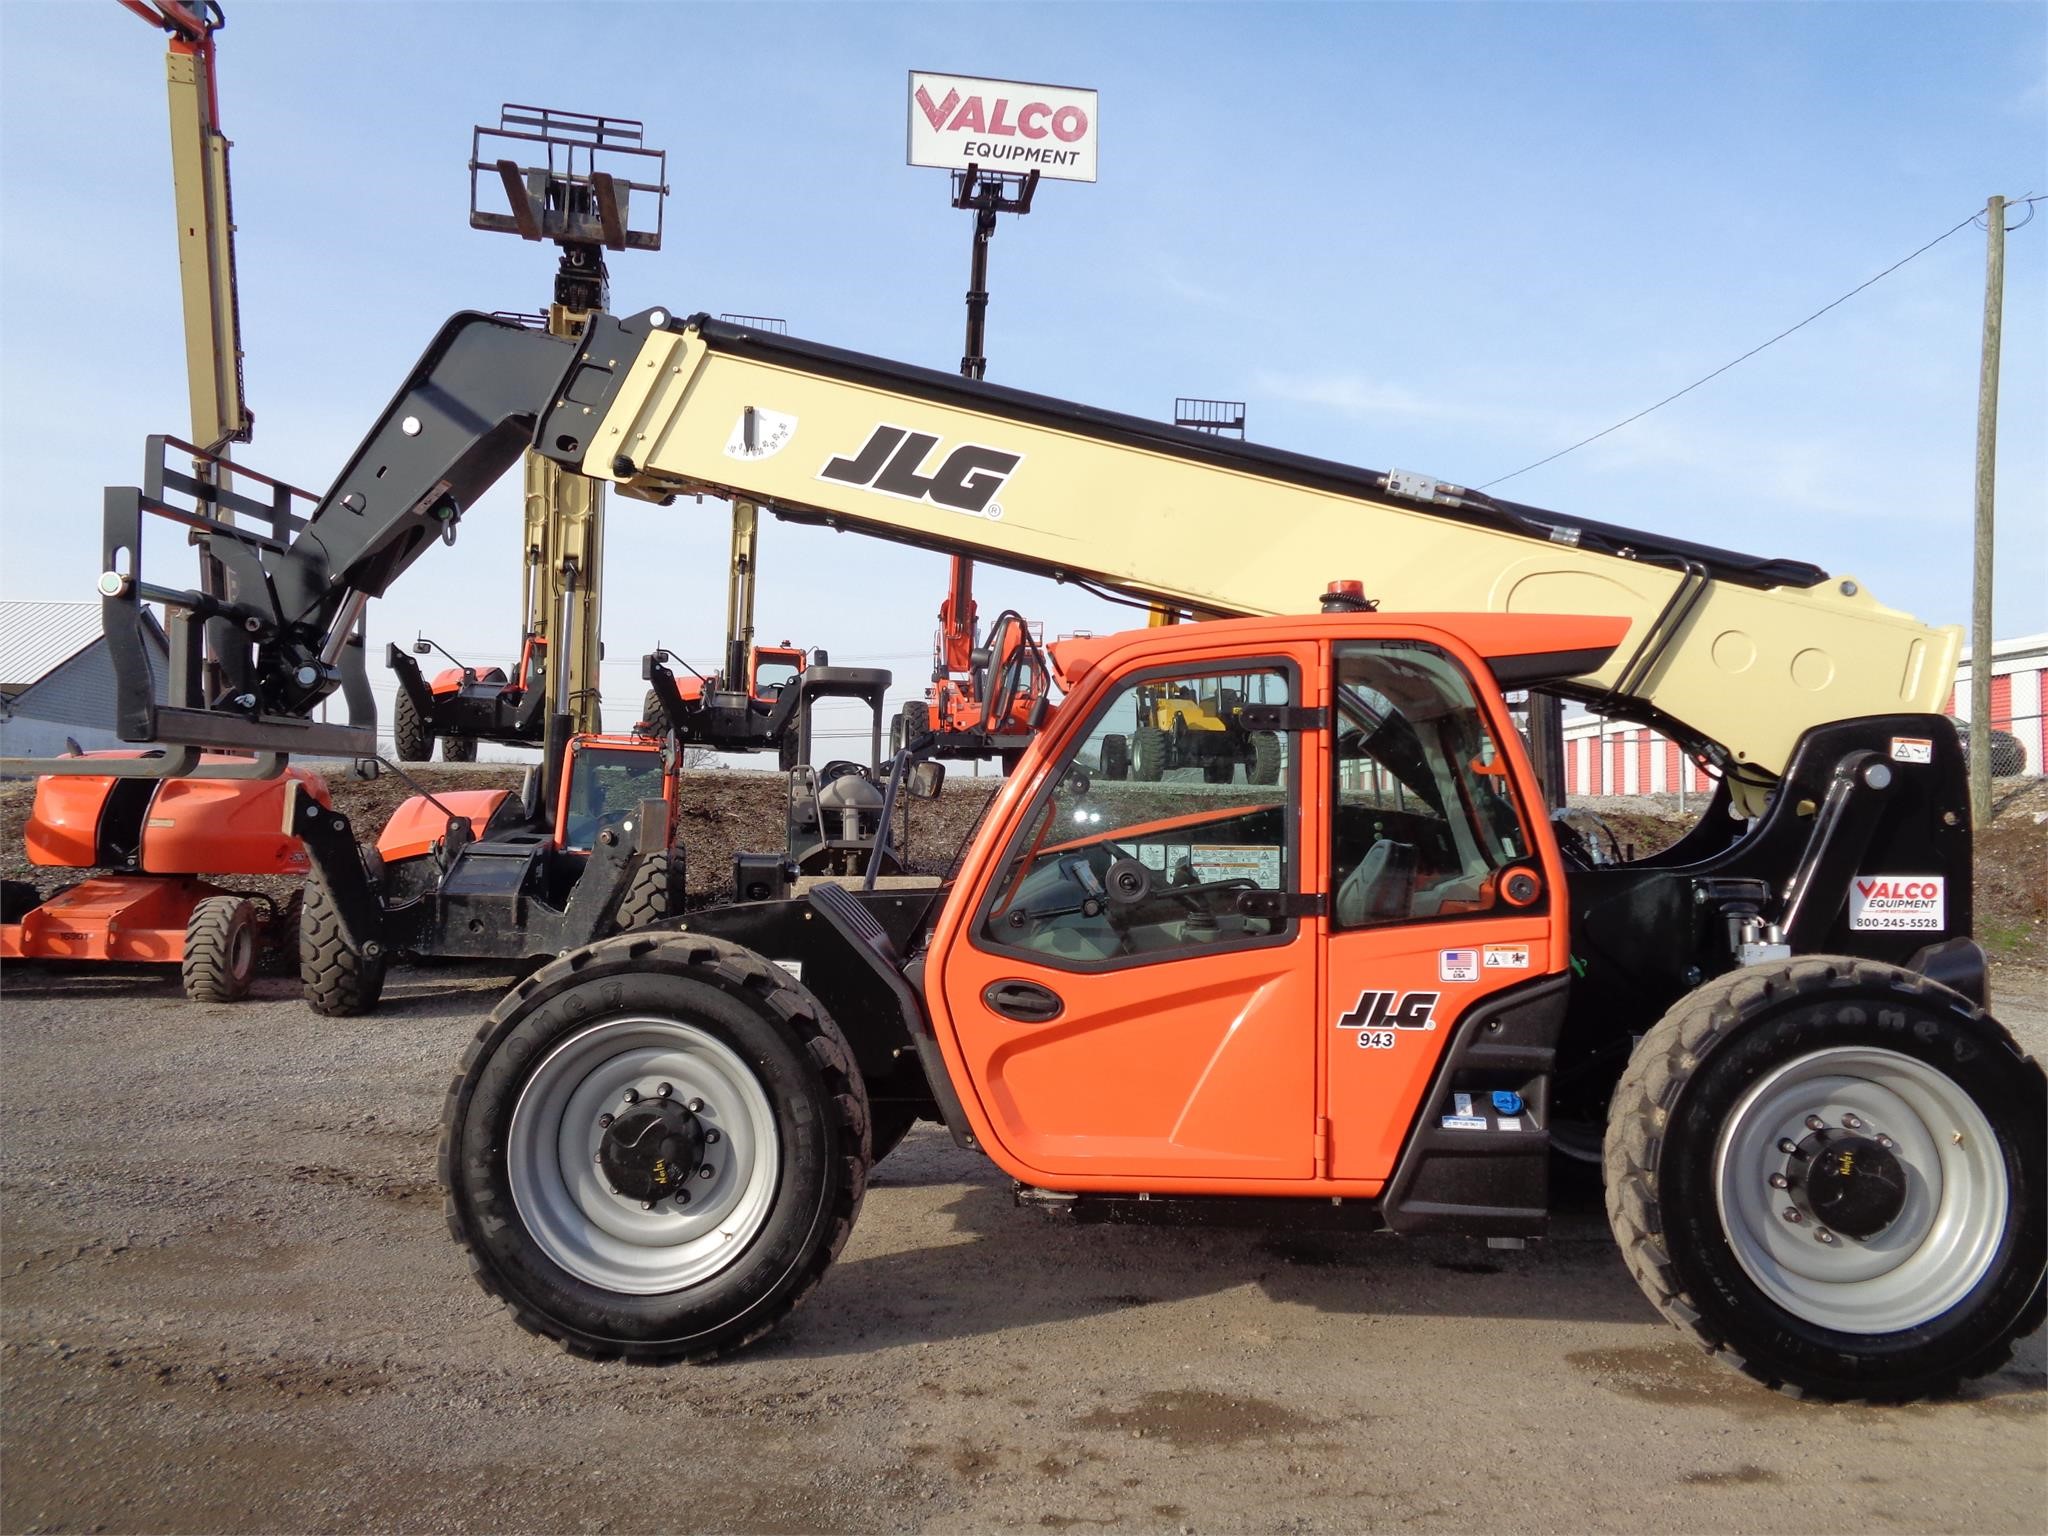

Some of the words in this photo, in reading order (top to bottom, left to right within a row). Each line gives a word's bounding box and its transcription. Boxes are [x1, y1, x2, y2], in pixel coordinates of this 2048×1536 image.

[915, 84, 1088, 142] VALCO
[963, 142, 1080, 165] EQUIPMENT
[820, 425, 1021, 513] JLG
[1856, 880, 1938, 900] VALCO
[1869, 899, 1937, 909] EQUIPMENT
[1856, 918, 1938, 928] 800-245-5528
[1340, 992, 1438, 1028] JLG
[1360, 1033, 1393, 1047] 943
